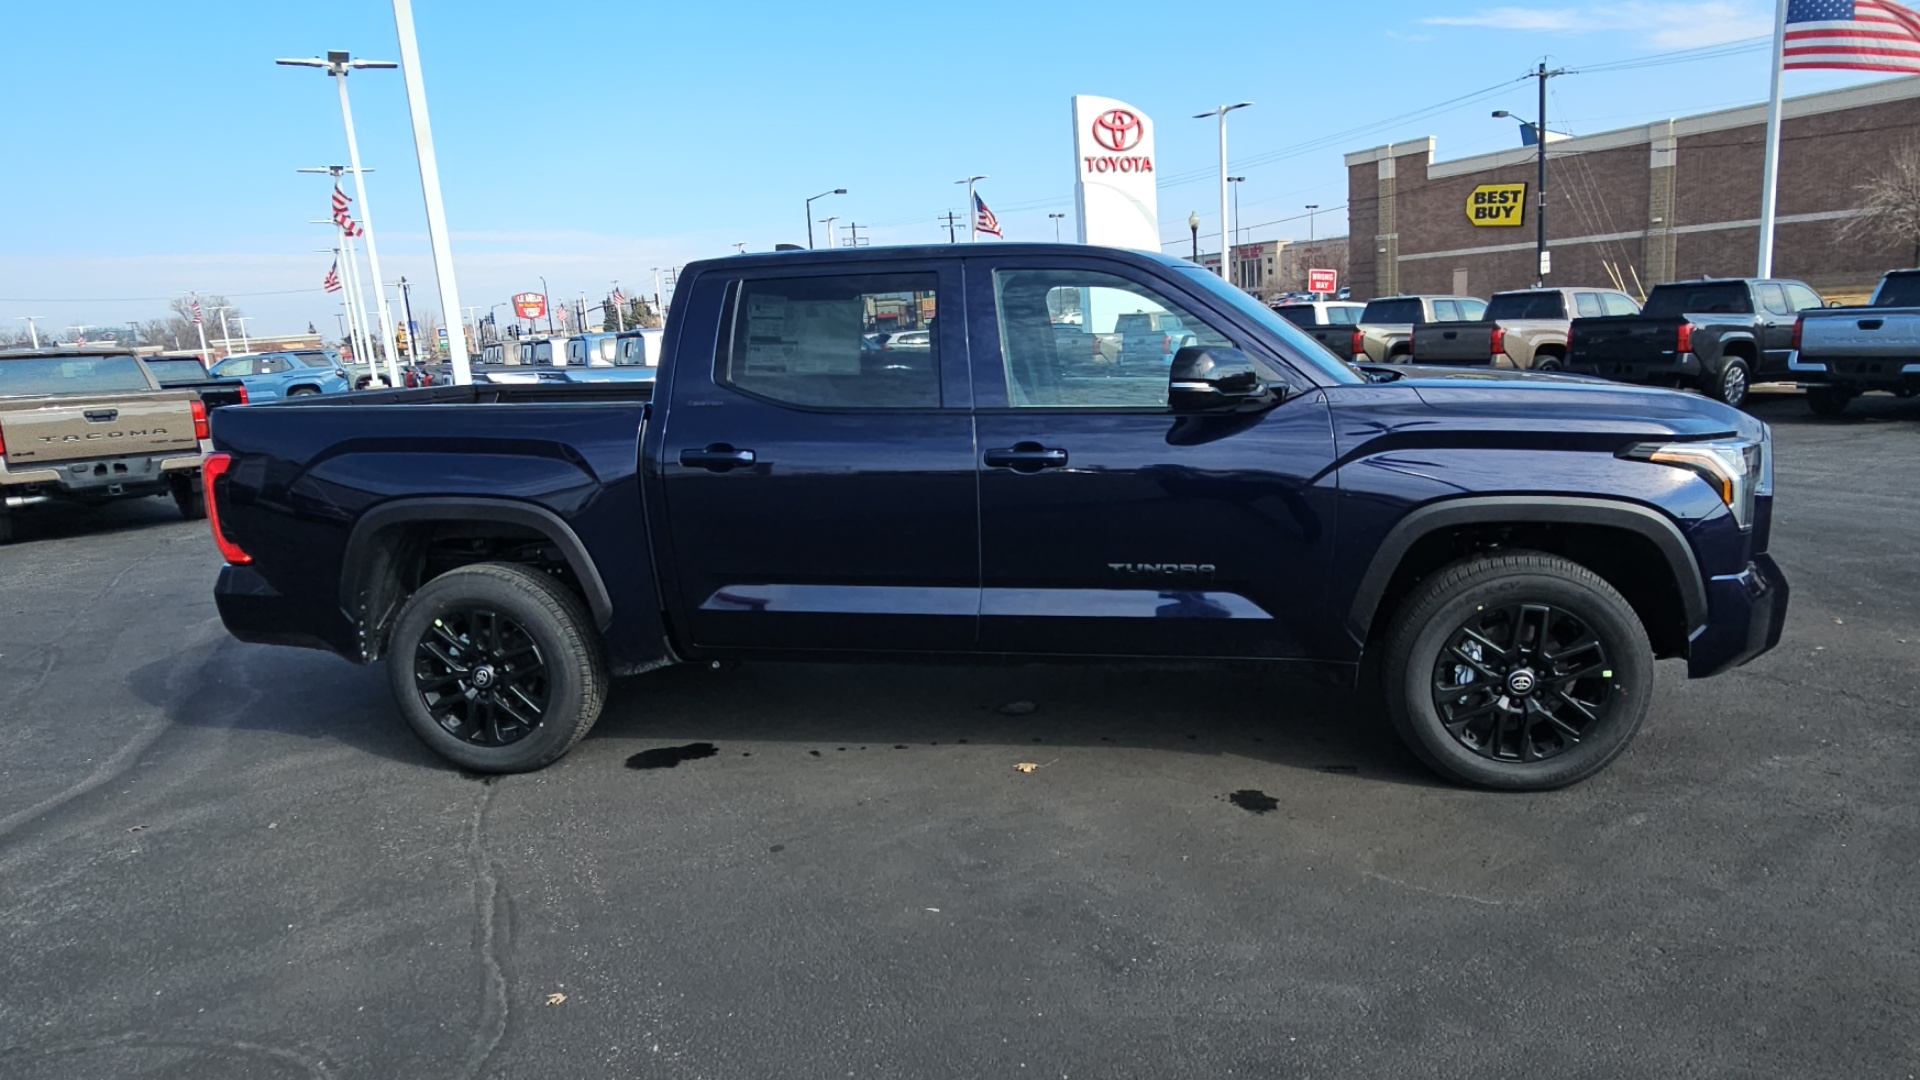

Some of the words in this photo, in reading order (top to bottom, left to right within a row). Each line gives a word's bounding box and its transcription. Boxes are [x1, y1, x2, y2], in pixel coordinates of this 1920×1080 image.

[1084, 156, 1153, 173] TOYOTA
[1474, 190, 1521, 205] BEST
[1475, 206, 1515, 219] BUY
[1312, 273, 1334, 281] WRONG
[39, 428, 168, 443] TACOMA
[1107, 563, 1215, 575] TUNDRA
